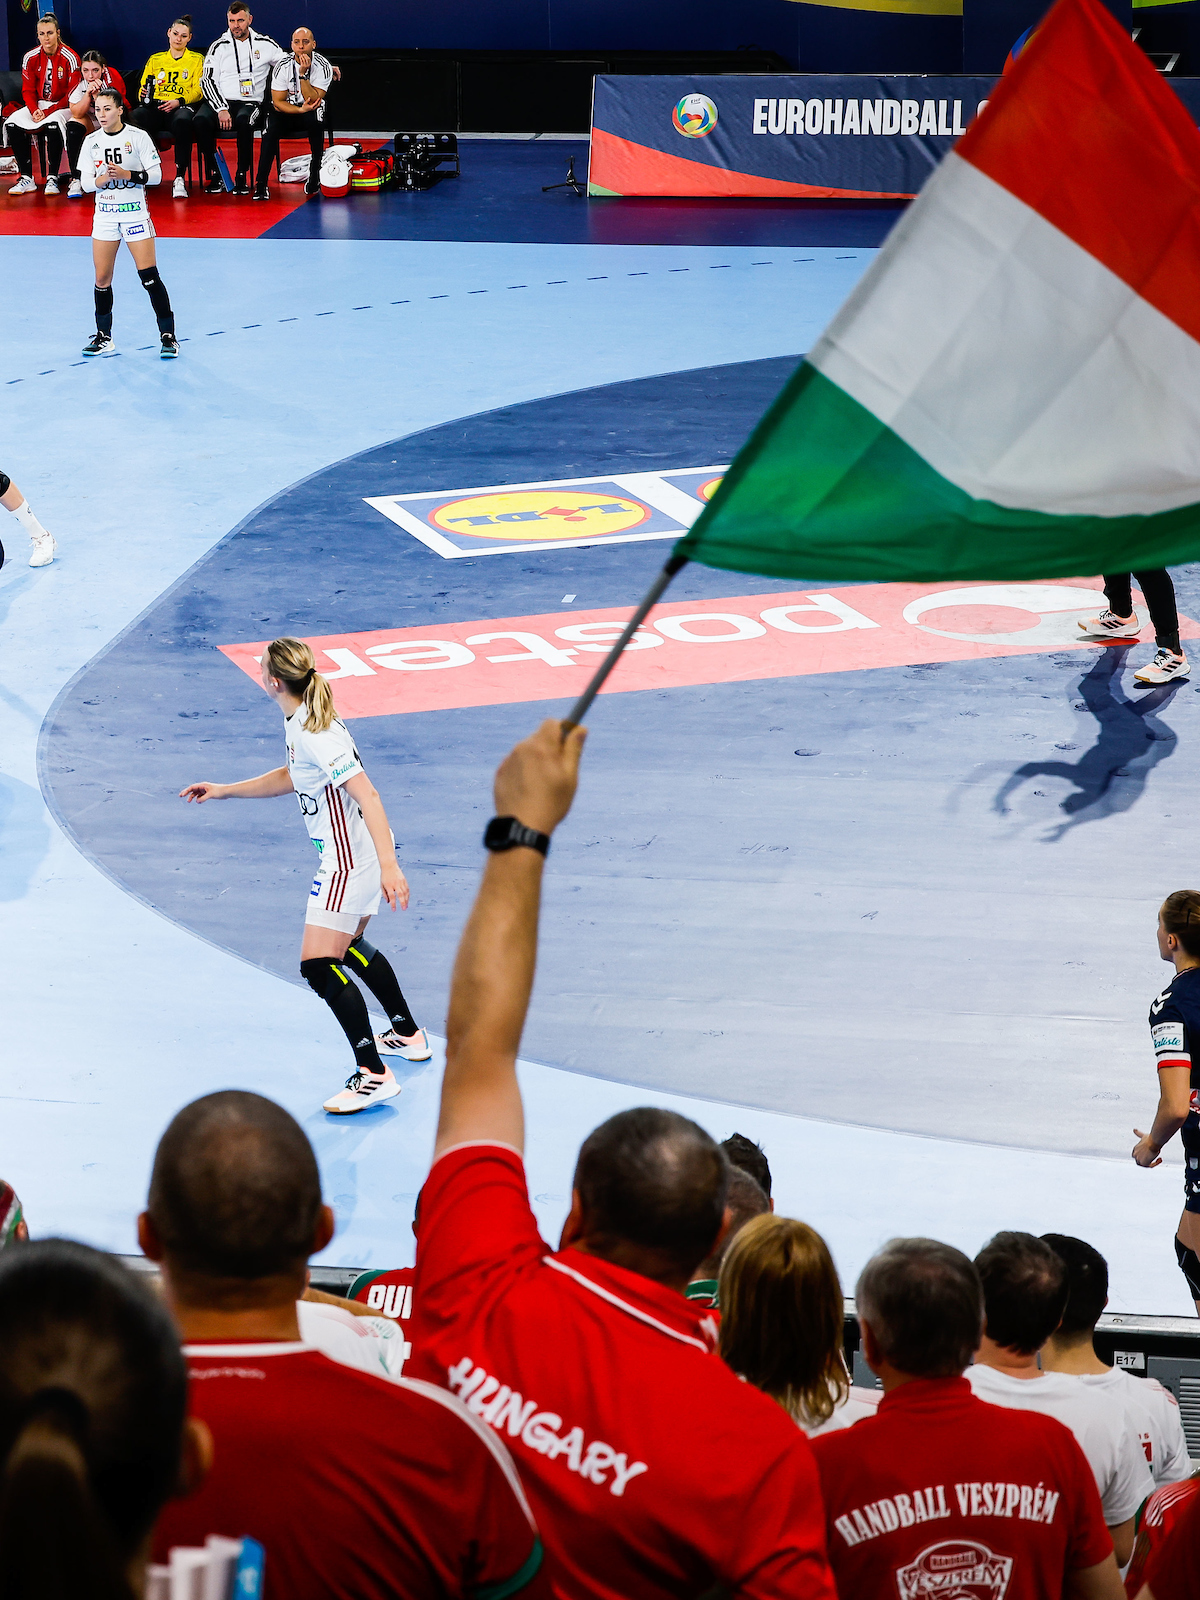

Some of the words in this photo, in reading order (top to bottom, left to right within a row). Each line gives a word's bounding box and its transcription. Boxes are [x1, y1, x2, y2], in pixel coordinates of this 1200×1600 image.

[753, 98, 966, 136] EUROHANDBALL
[104, 147, 123, 165] 66
[1115, 1356, 1137, 1365] E17
[448, 1356, 649, 1497] HUNGARY
[834, 1484, 951, 1548] HANDBALL
[954, 1481, 1060, 1526] VESZPRÉM
